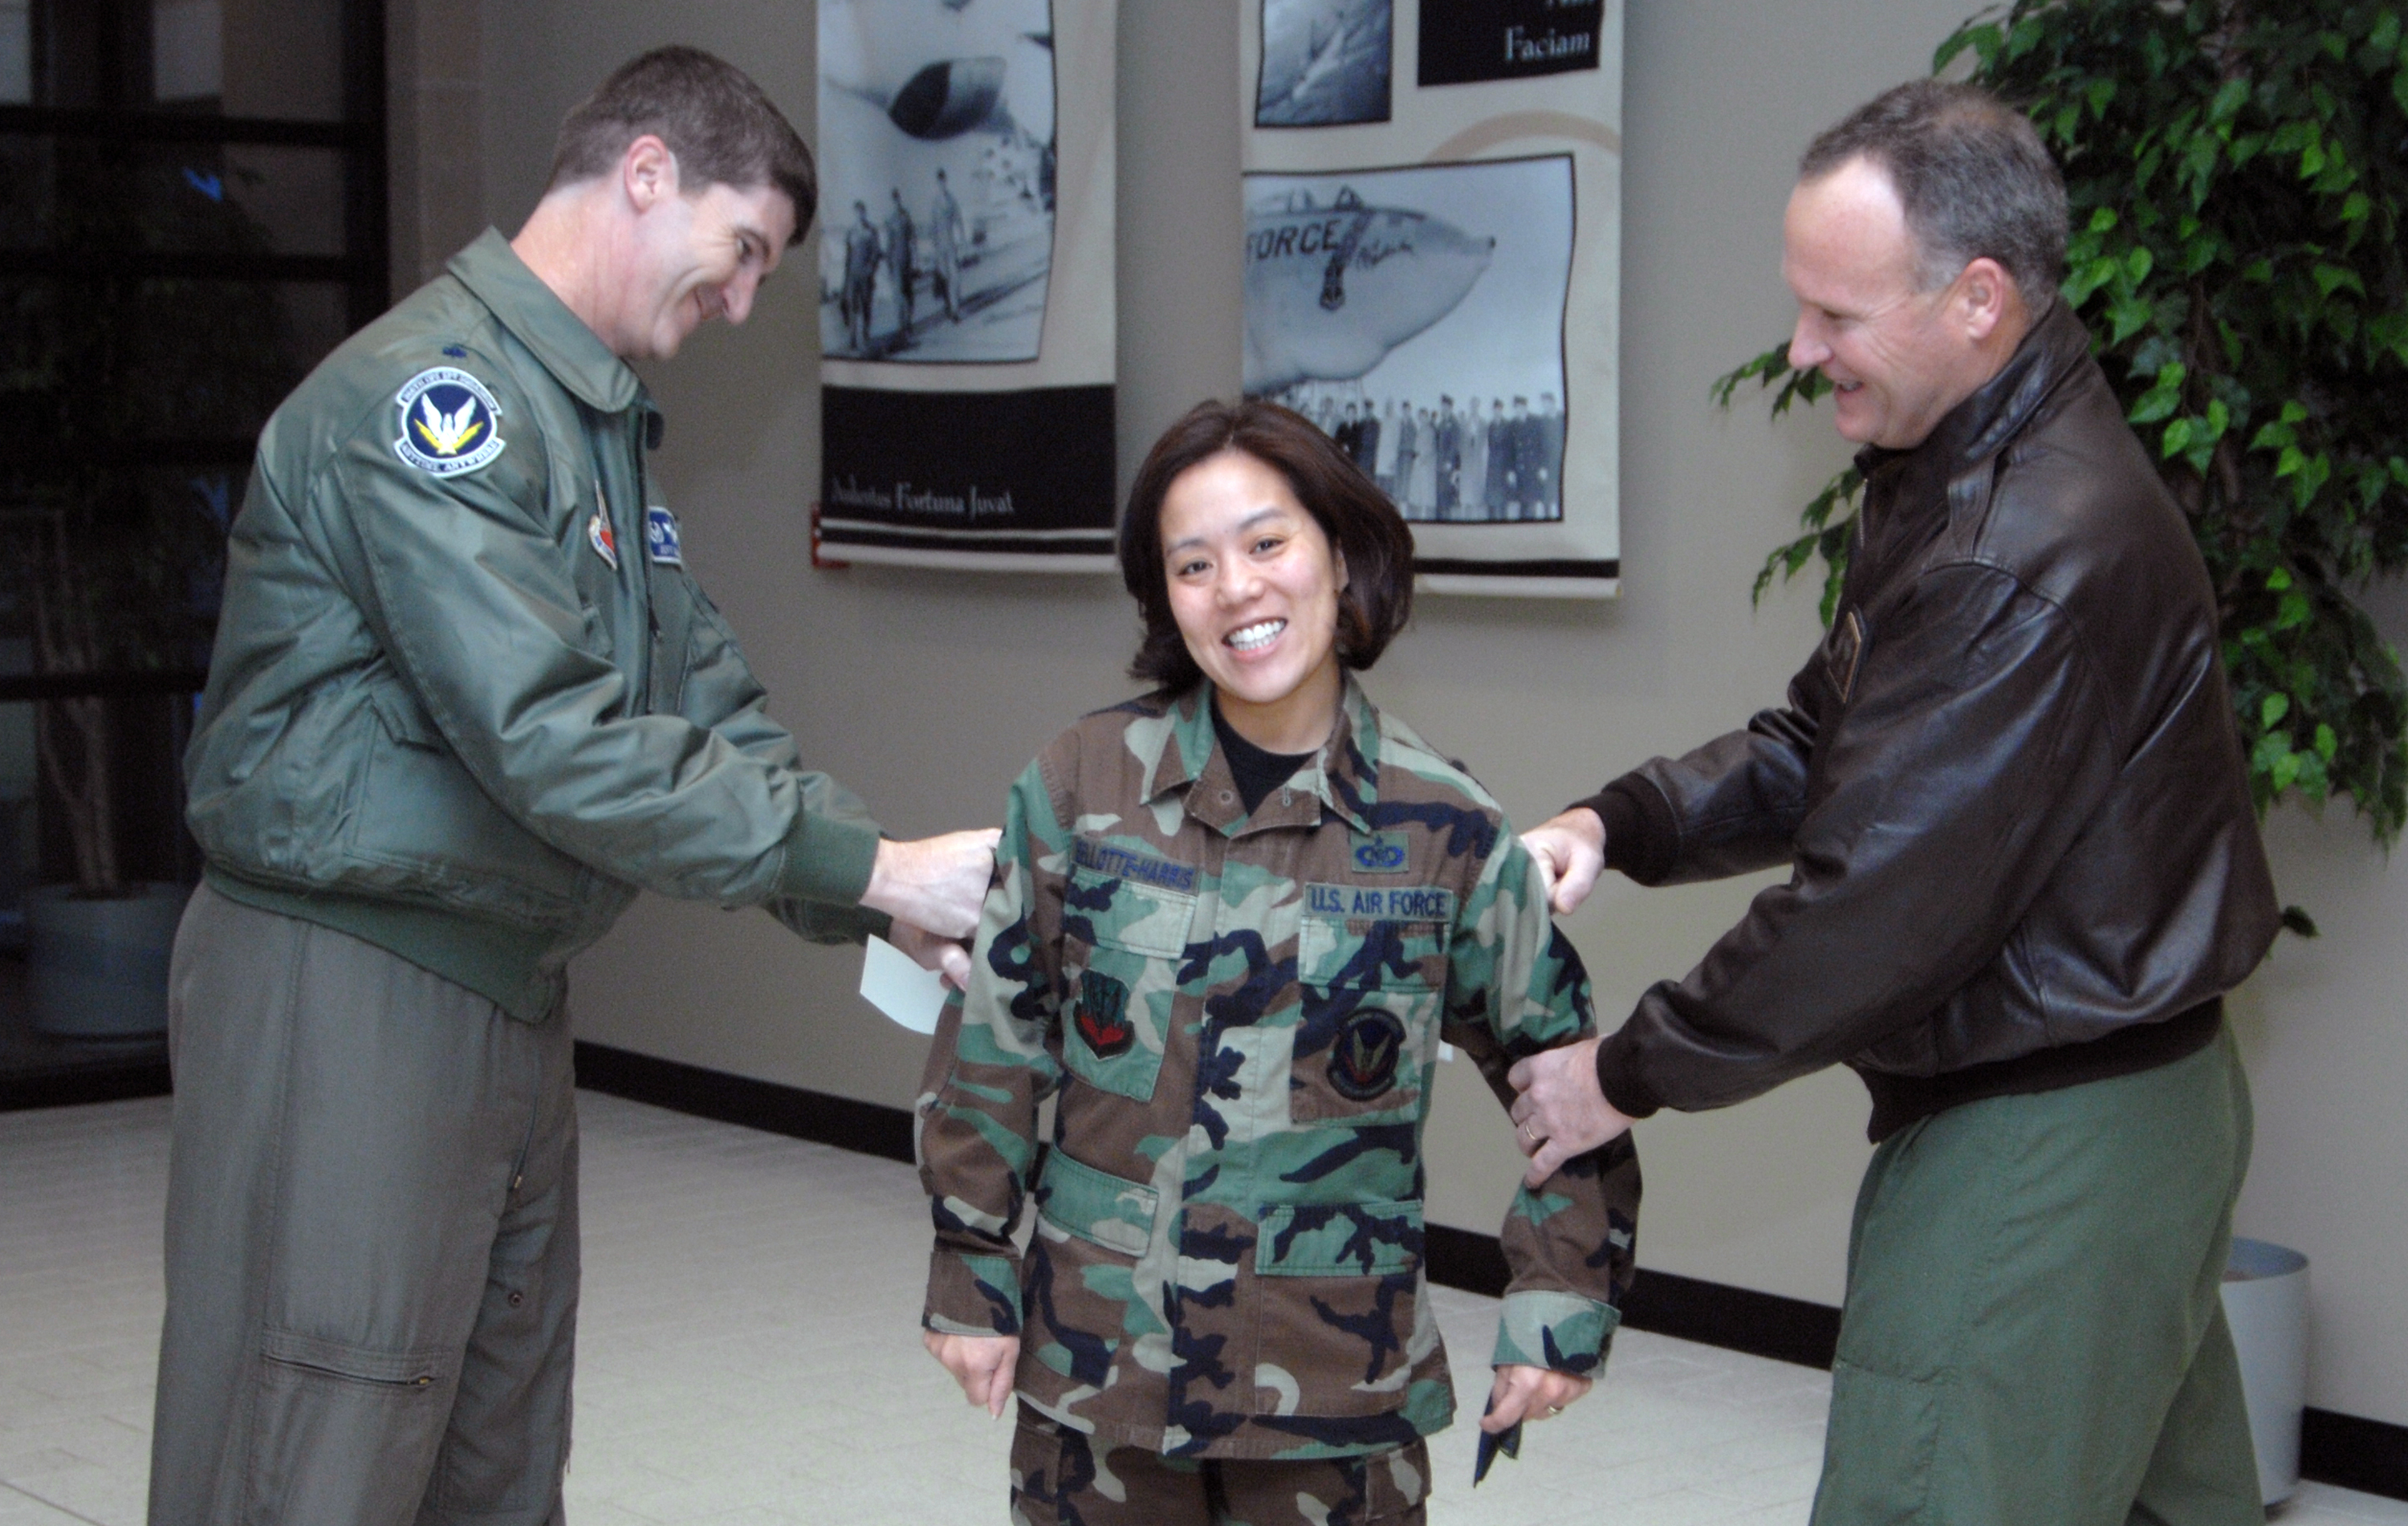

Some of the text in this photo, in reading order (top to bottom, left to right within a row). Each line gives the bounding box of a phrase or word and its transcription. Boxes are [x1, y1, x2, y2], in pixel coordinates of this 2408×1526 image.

[1505, 25, 1590, 61] Faciam
[896, 482, 965, 513] Fortuna
[1311, 888, 1446, 916] U.S. AIR FORCE
